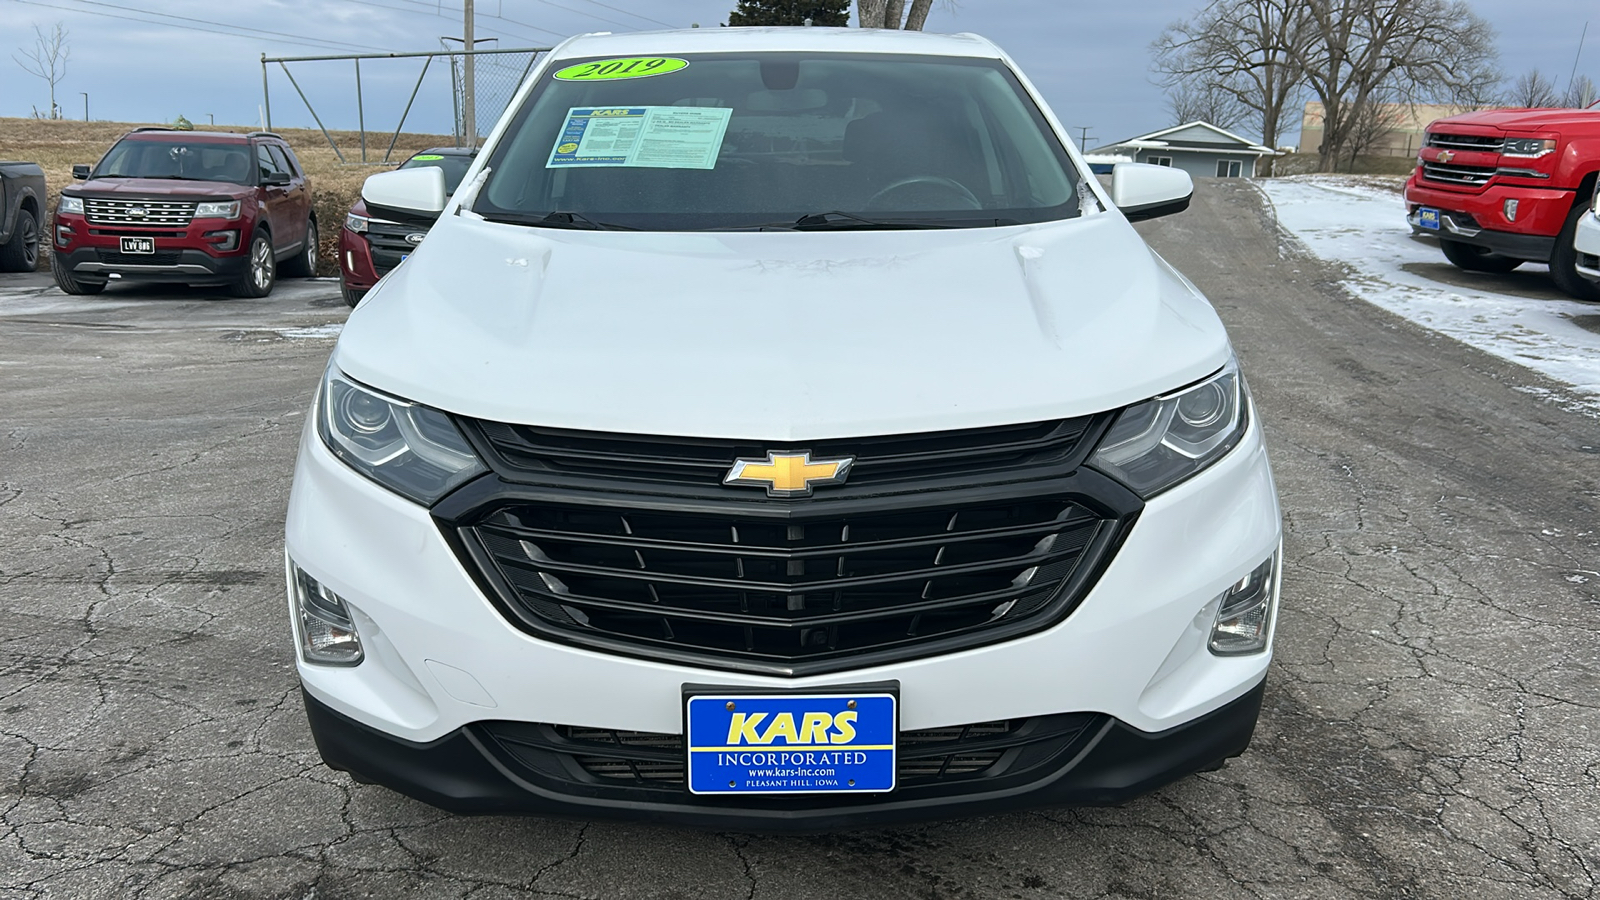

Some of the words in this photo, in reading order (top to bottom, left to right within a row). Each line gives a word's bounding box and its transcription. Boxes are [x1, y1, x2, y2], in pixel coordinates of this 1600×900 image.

[573, 58, 667, 78] 2019
[726, 711, 858, 745] KARS
[717, 752, 867, 766] INCORPORATED
[748, 767, 836, 777] www.kars-inc.com
